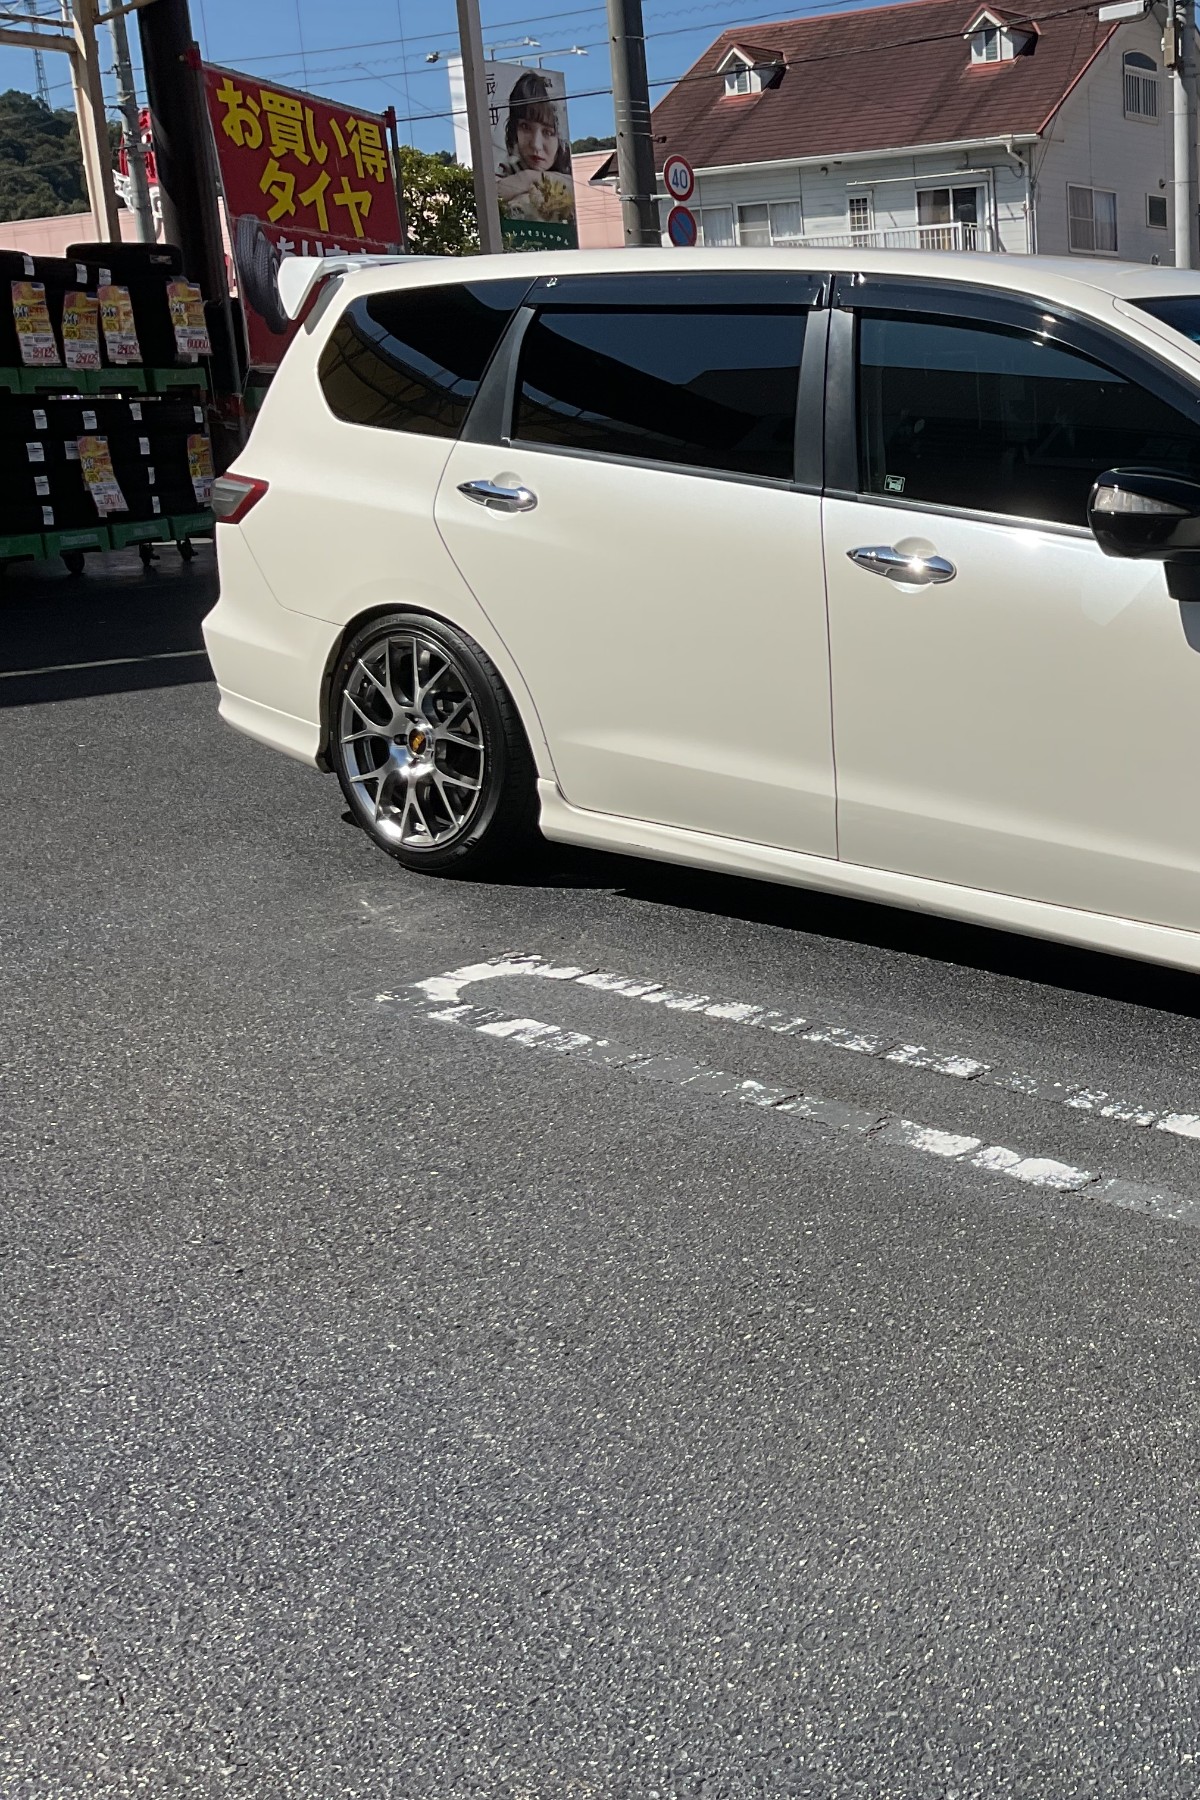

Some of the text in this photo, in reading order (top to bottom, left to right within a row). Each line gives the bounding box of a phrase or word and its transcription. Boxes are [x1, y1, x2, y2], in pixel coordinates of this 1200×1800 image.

[216, 77, 388, 183] お買い得
[259, 158, 373, 238] タイヤ
[671, 168, 688, 189] 40
